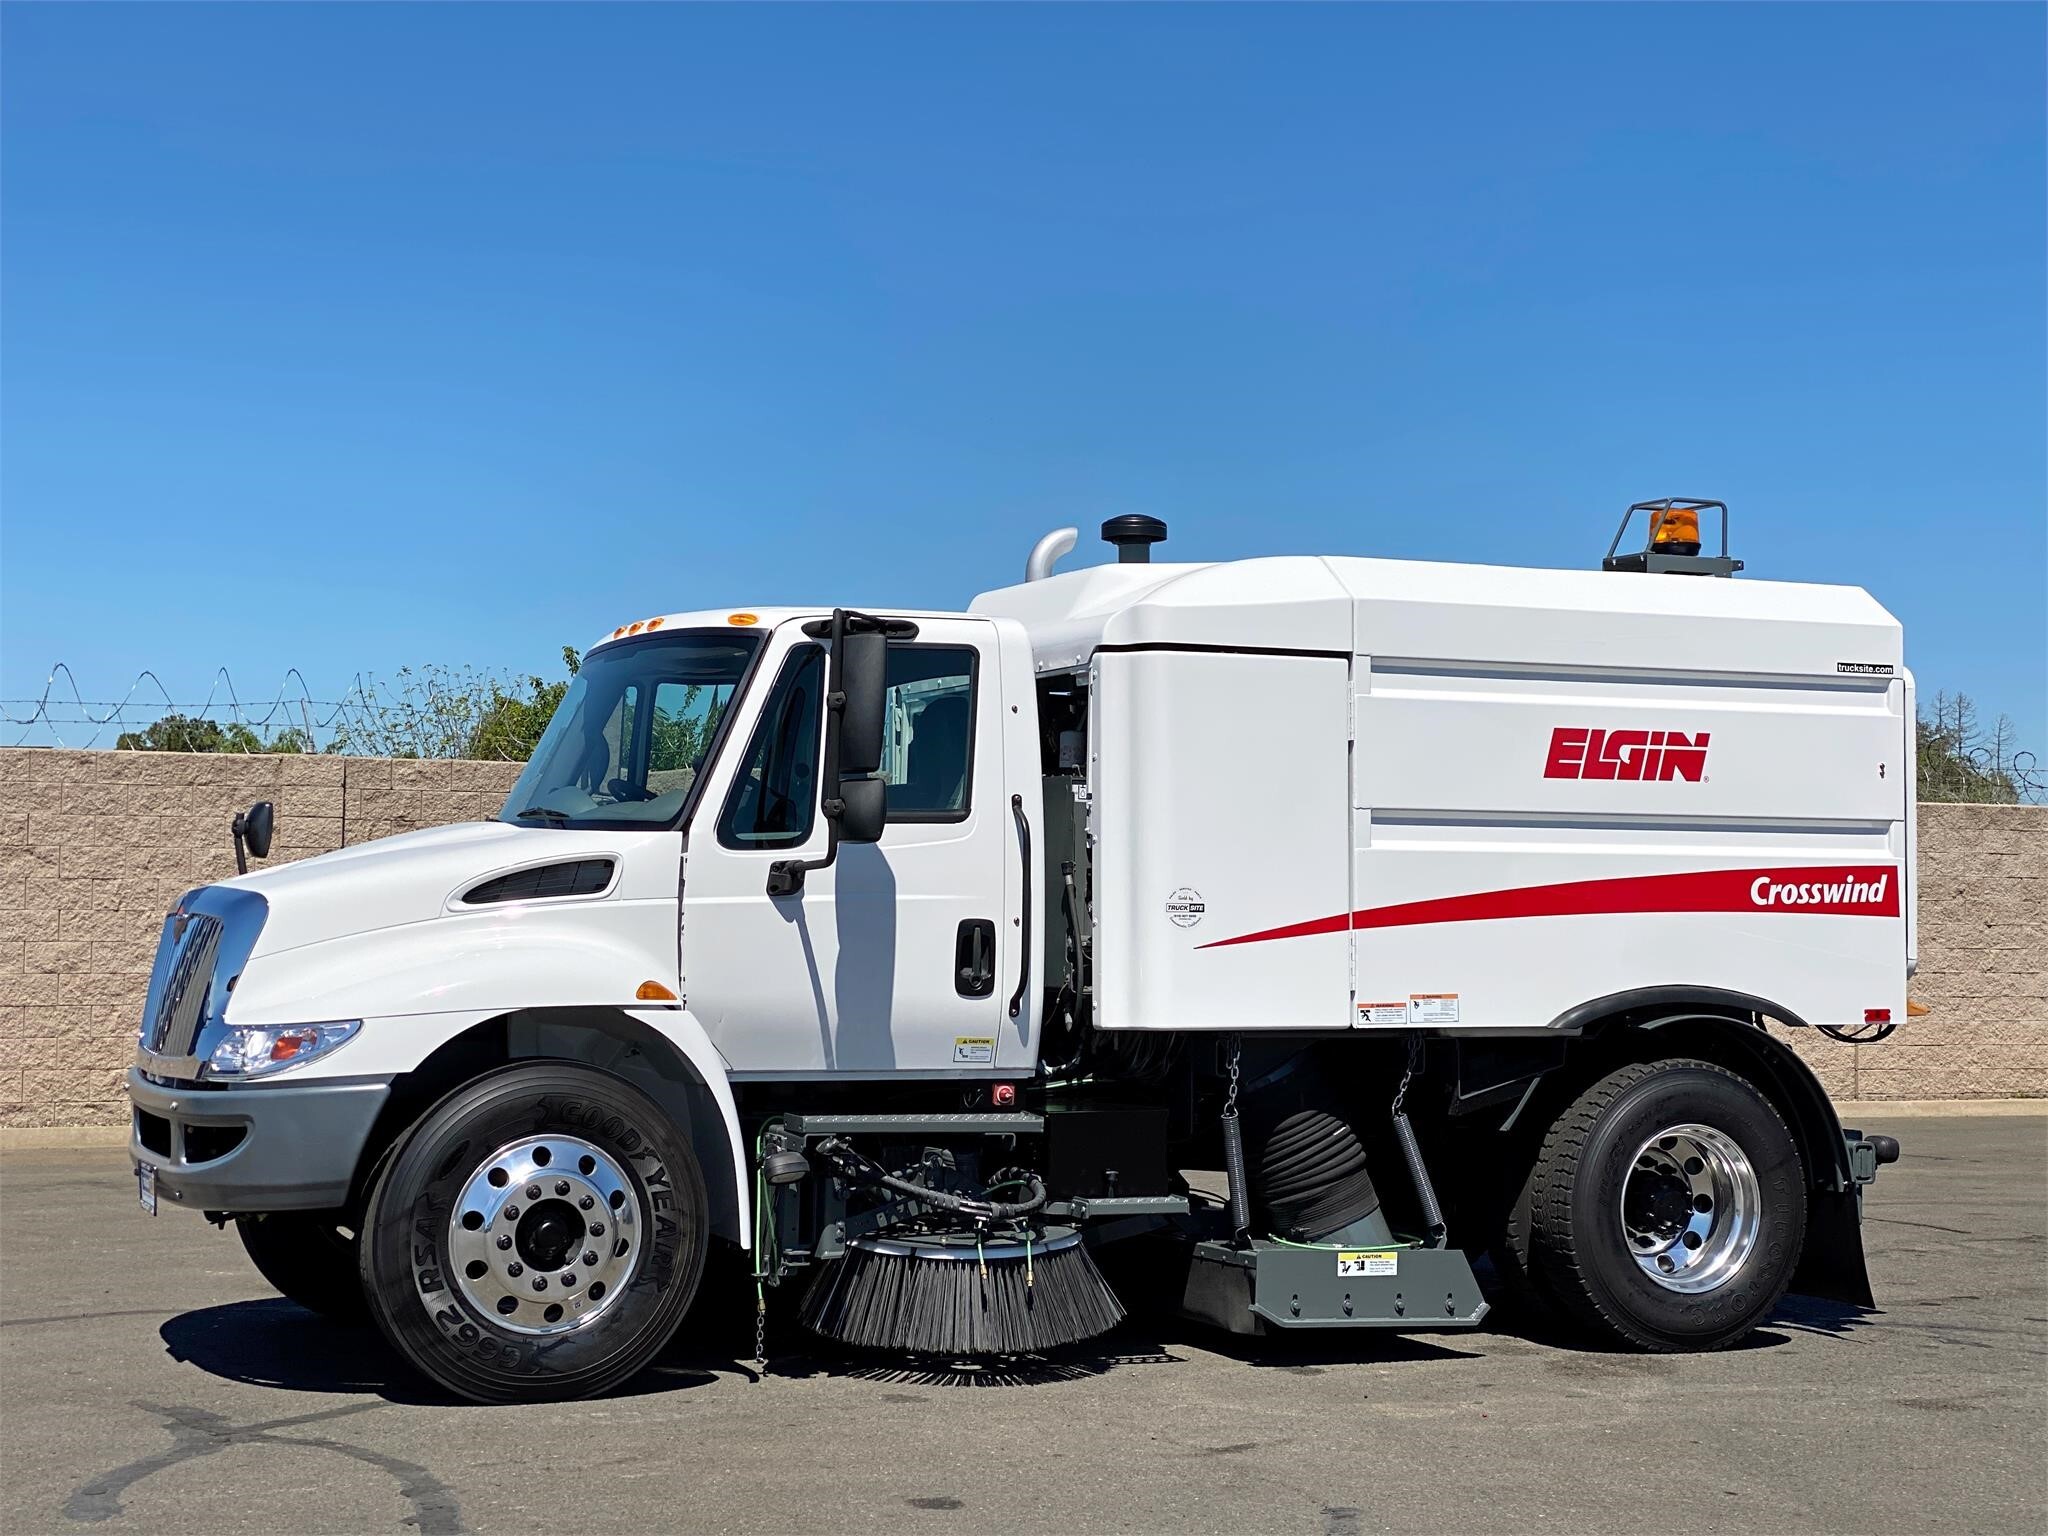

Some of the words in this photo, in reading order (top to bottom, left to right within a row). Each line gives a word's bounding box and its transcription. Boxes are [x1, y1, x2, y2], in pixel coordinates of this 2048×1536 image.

[1837, 664, 1893, 674] trucksite.com
[1543, 727, 1711, 783] ELGIN
[1750, 874, 1888, 906] Crosswind
